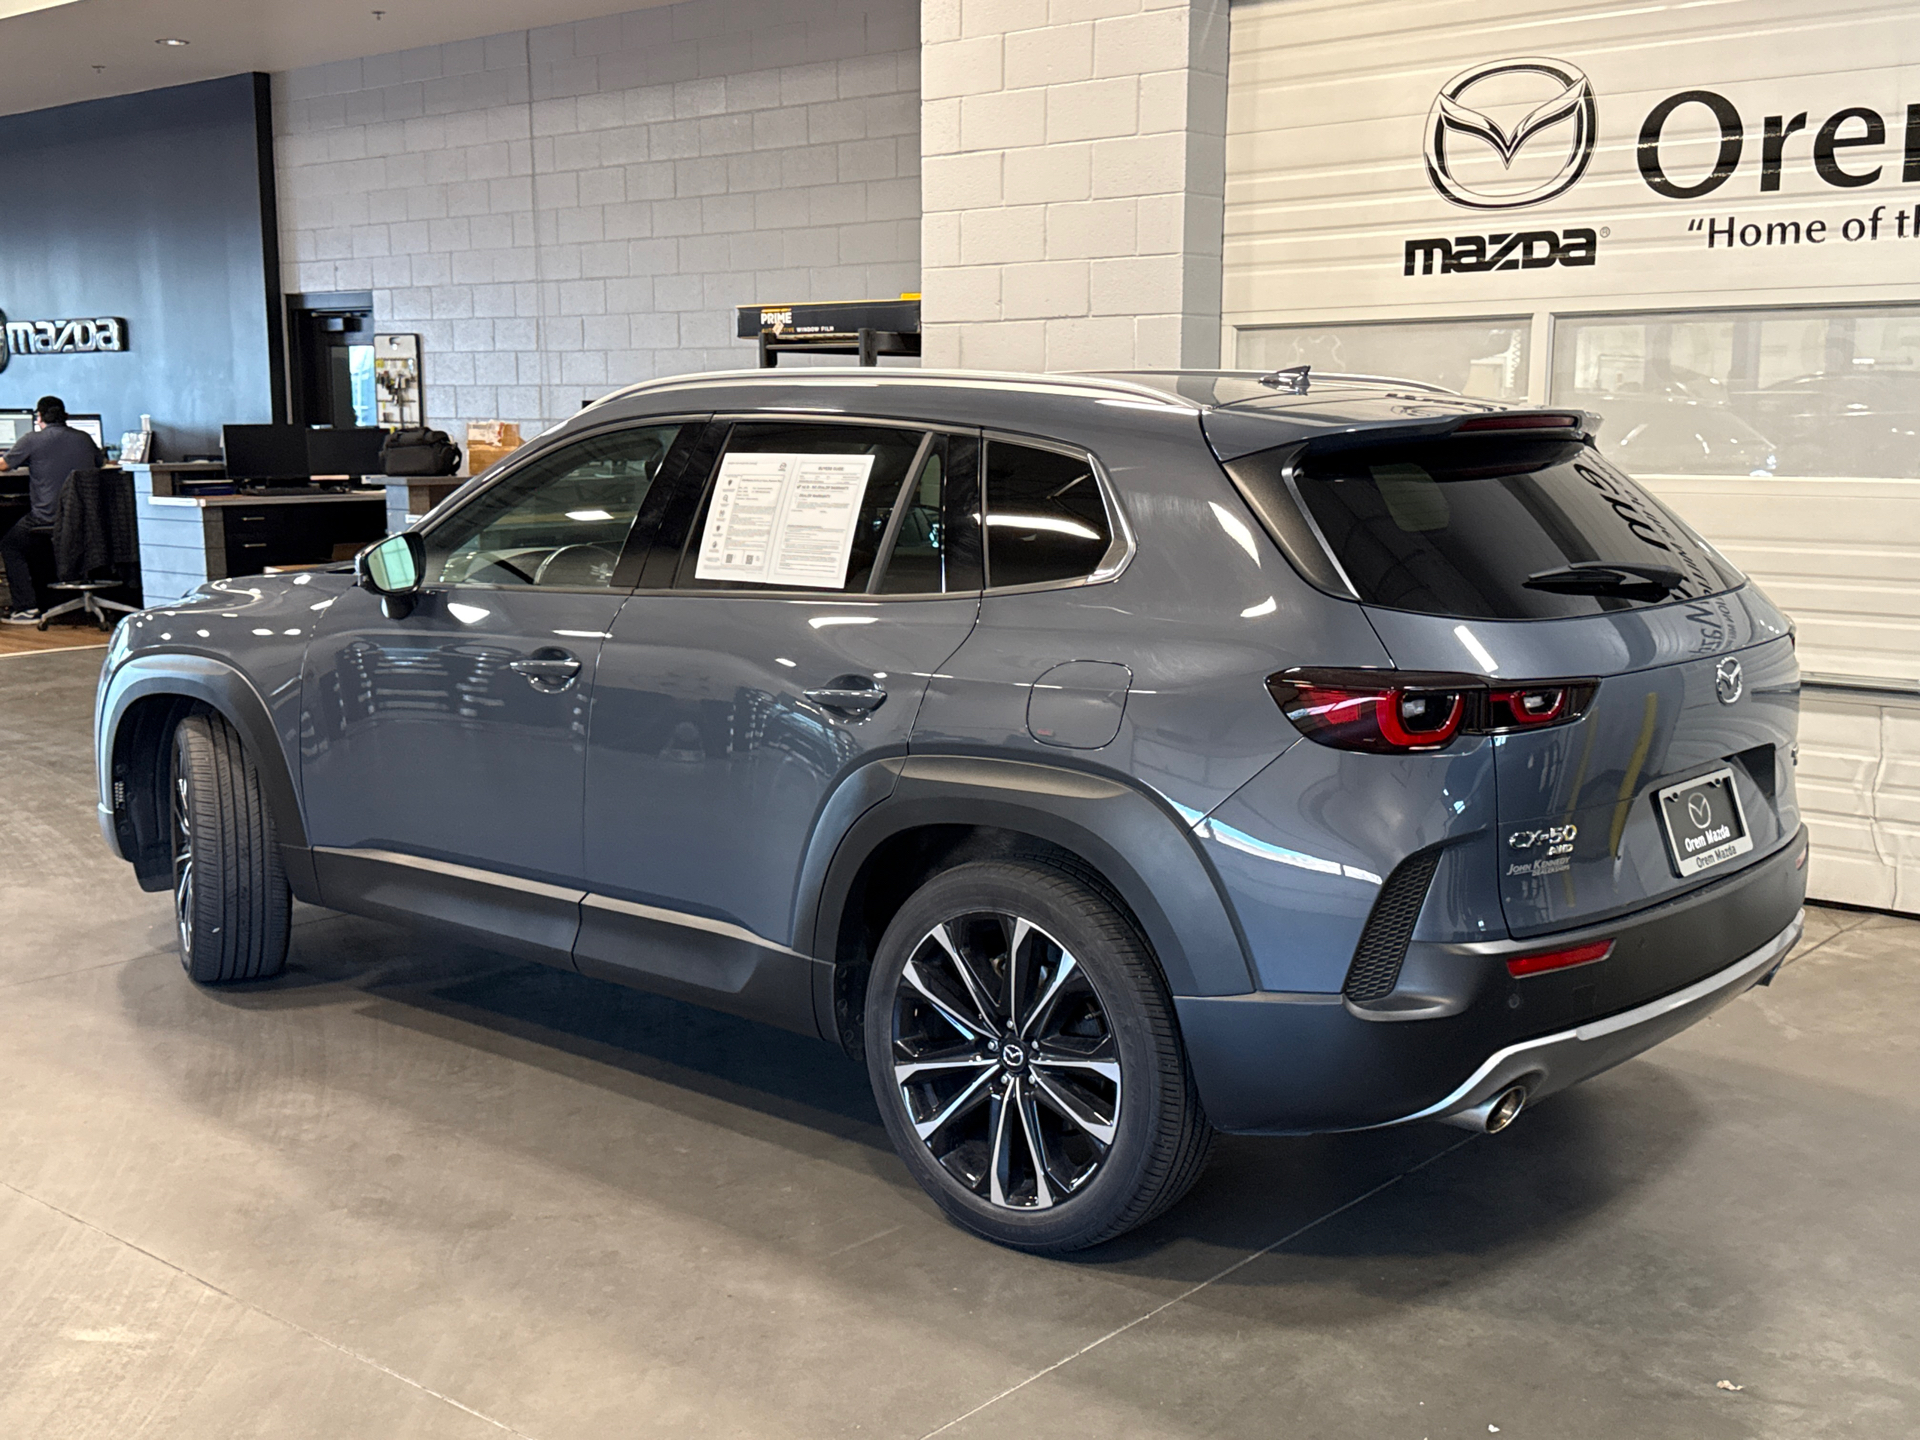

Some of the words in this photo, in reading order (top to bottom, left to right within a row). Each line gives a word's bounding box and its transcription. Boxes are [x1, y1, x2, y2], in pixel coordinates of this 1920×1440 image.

[1841, 205, 1886, 242] of
[761, 312, 792, 324] PRIME
[1509, 824, 1578, 849] CX-50
[1684, 836, 1707, 853] Orem
[1705, 824, 1731, 845] Mazda
[1547, 843, 1574, 856] AWD
[1696, 852, 1715, 868] Orem
[1714, 844, 1737, 861] Mazda
